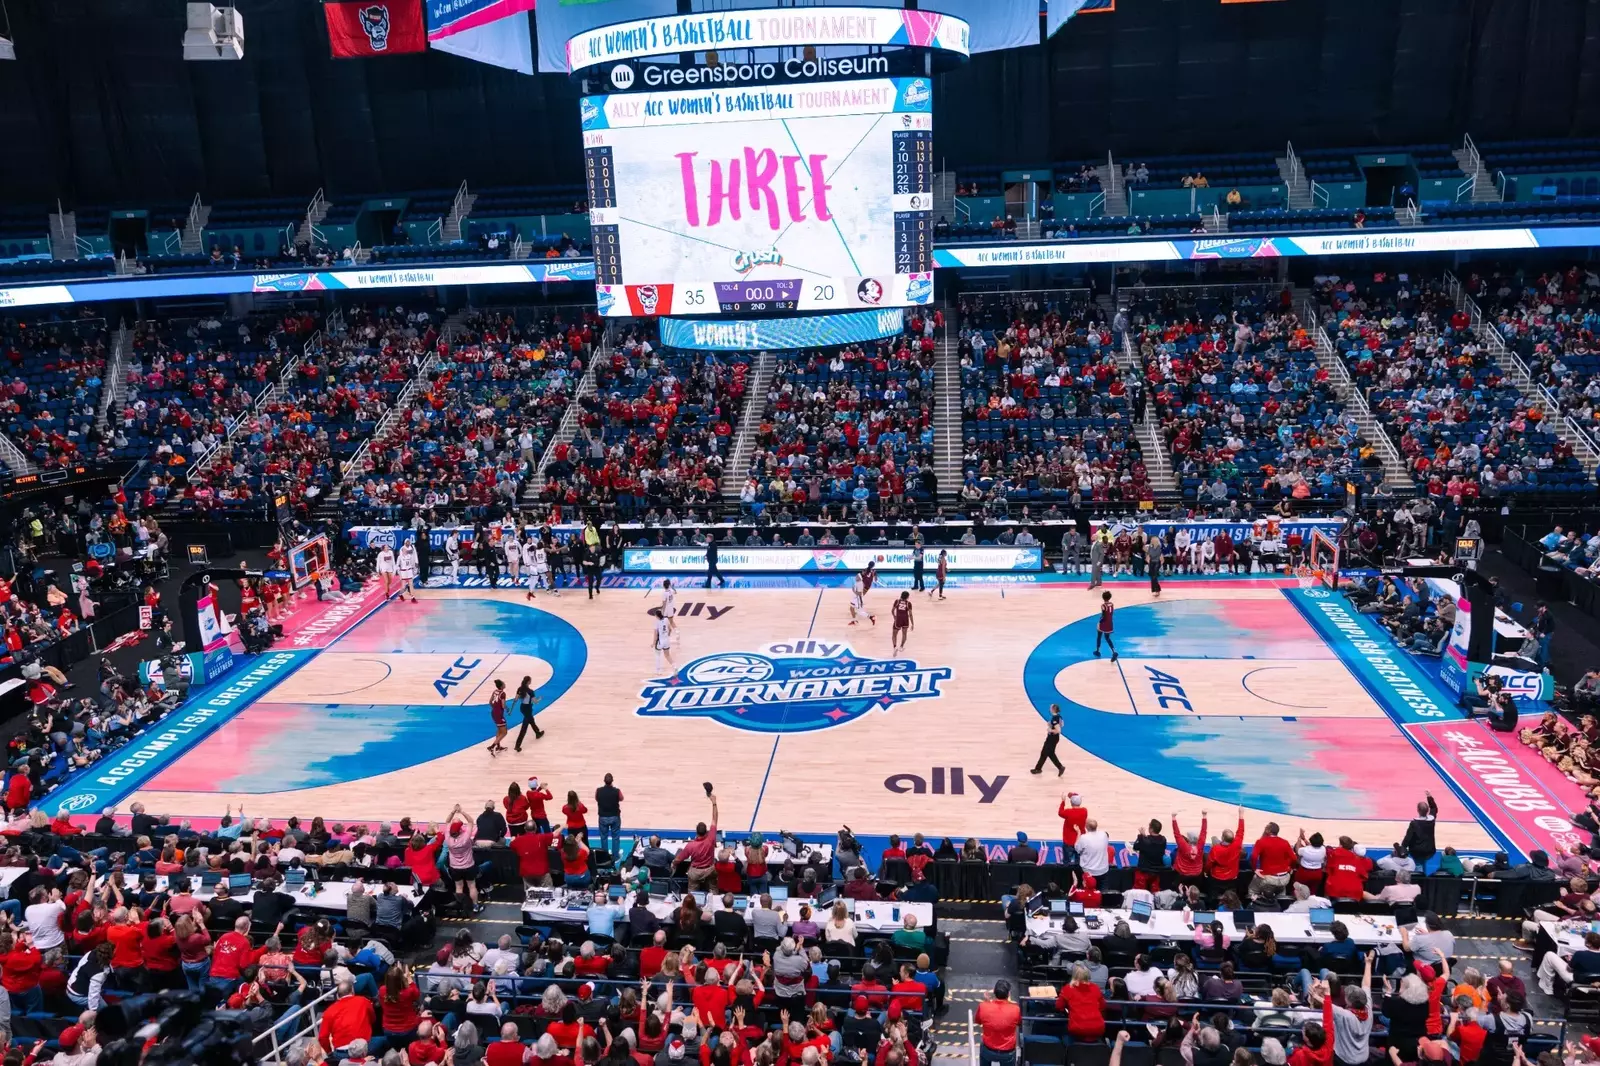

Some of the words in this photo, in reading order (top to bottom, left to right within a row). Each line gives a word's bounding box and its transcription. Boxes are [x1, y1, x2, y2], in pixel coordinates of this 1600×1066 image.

[588, 36, 602, 57] ACC
[605, 21, 658, 54] WOMEN'S
[662, 18, 753, 48] BASKETBALL
[757, 16, 877, 42] TOURNAMENT
[643, 59, 776, 86] Greensboro
[784, 54, 889, 79] Coliseum
[613, 101, 640, 119] ALLY
[644, 99, 664, 117] ACC
[667, 92, 721, 116] WOMEN'S
[725, 92, 795, 113] BASKETBALL
[797, 87, 889, 109] TOURNAMENT
[899, 142, 906, 151] 2
[897, 152, 909, 162] 10
[897, 164, 907, 174] 21
[897, 175, 909, 184] 22
[674, 146, 832, 230] THREE
[897, 185, 909, 194] 35
[901, 221, 906, 231] 1
[901, 233, 907, 242] 3
[1321, 241, 1333, 250] ACC
[1336, 237, 1369, 249] WOMEN'S
[1372, 237, 1415, 248] BASKETBALL
[901, 244, 907, 252] 4
[992, 249, 1022, 261] WOMEN'S
[1026, 250, 1065, 260] BASKETBALL
[730, 246, 783, 274] Crush
[899, 254, 910, 264] 22
[899, 265, 910, 274] 24
[400, 273, 434, 282] BASKETBALL
[685, 290, 705, 305] 35
[746, 287, 774, 300] 00.0
[814, 285, 834, 301] 20
[734, 303, 740, 311] 0
[788, 301, 794, 309] 2
[693, 322, 759, 347] WOMEN'S
[370, 534, 393, 543] ACC
[769, 640, 842, 657] ally
[1316, 602, 1386, 654] ACCOMPLISH
[1366, 657, 1445, 717] GREATNESS
[209, 659, 234, 679] GREATNESS
[700, 664, 767, 676] ACC
[789, 660, 907, 679] WOMEN'S
[433, 656, 482, 698] ACC
[1499, 675, 1539, 689] ACC
[647, 668, 947, 712] TOURNAMENT
[1144, 665, 1194, 712] ACC
[97, 708, 217, 786] ACCOMPLISH
[208, 652, 295, 706] GREATNESS
[1443, 731, 1556, 811] #ACCWBB
[883, 767, 1010, 804] ally
